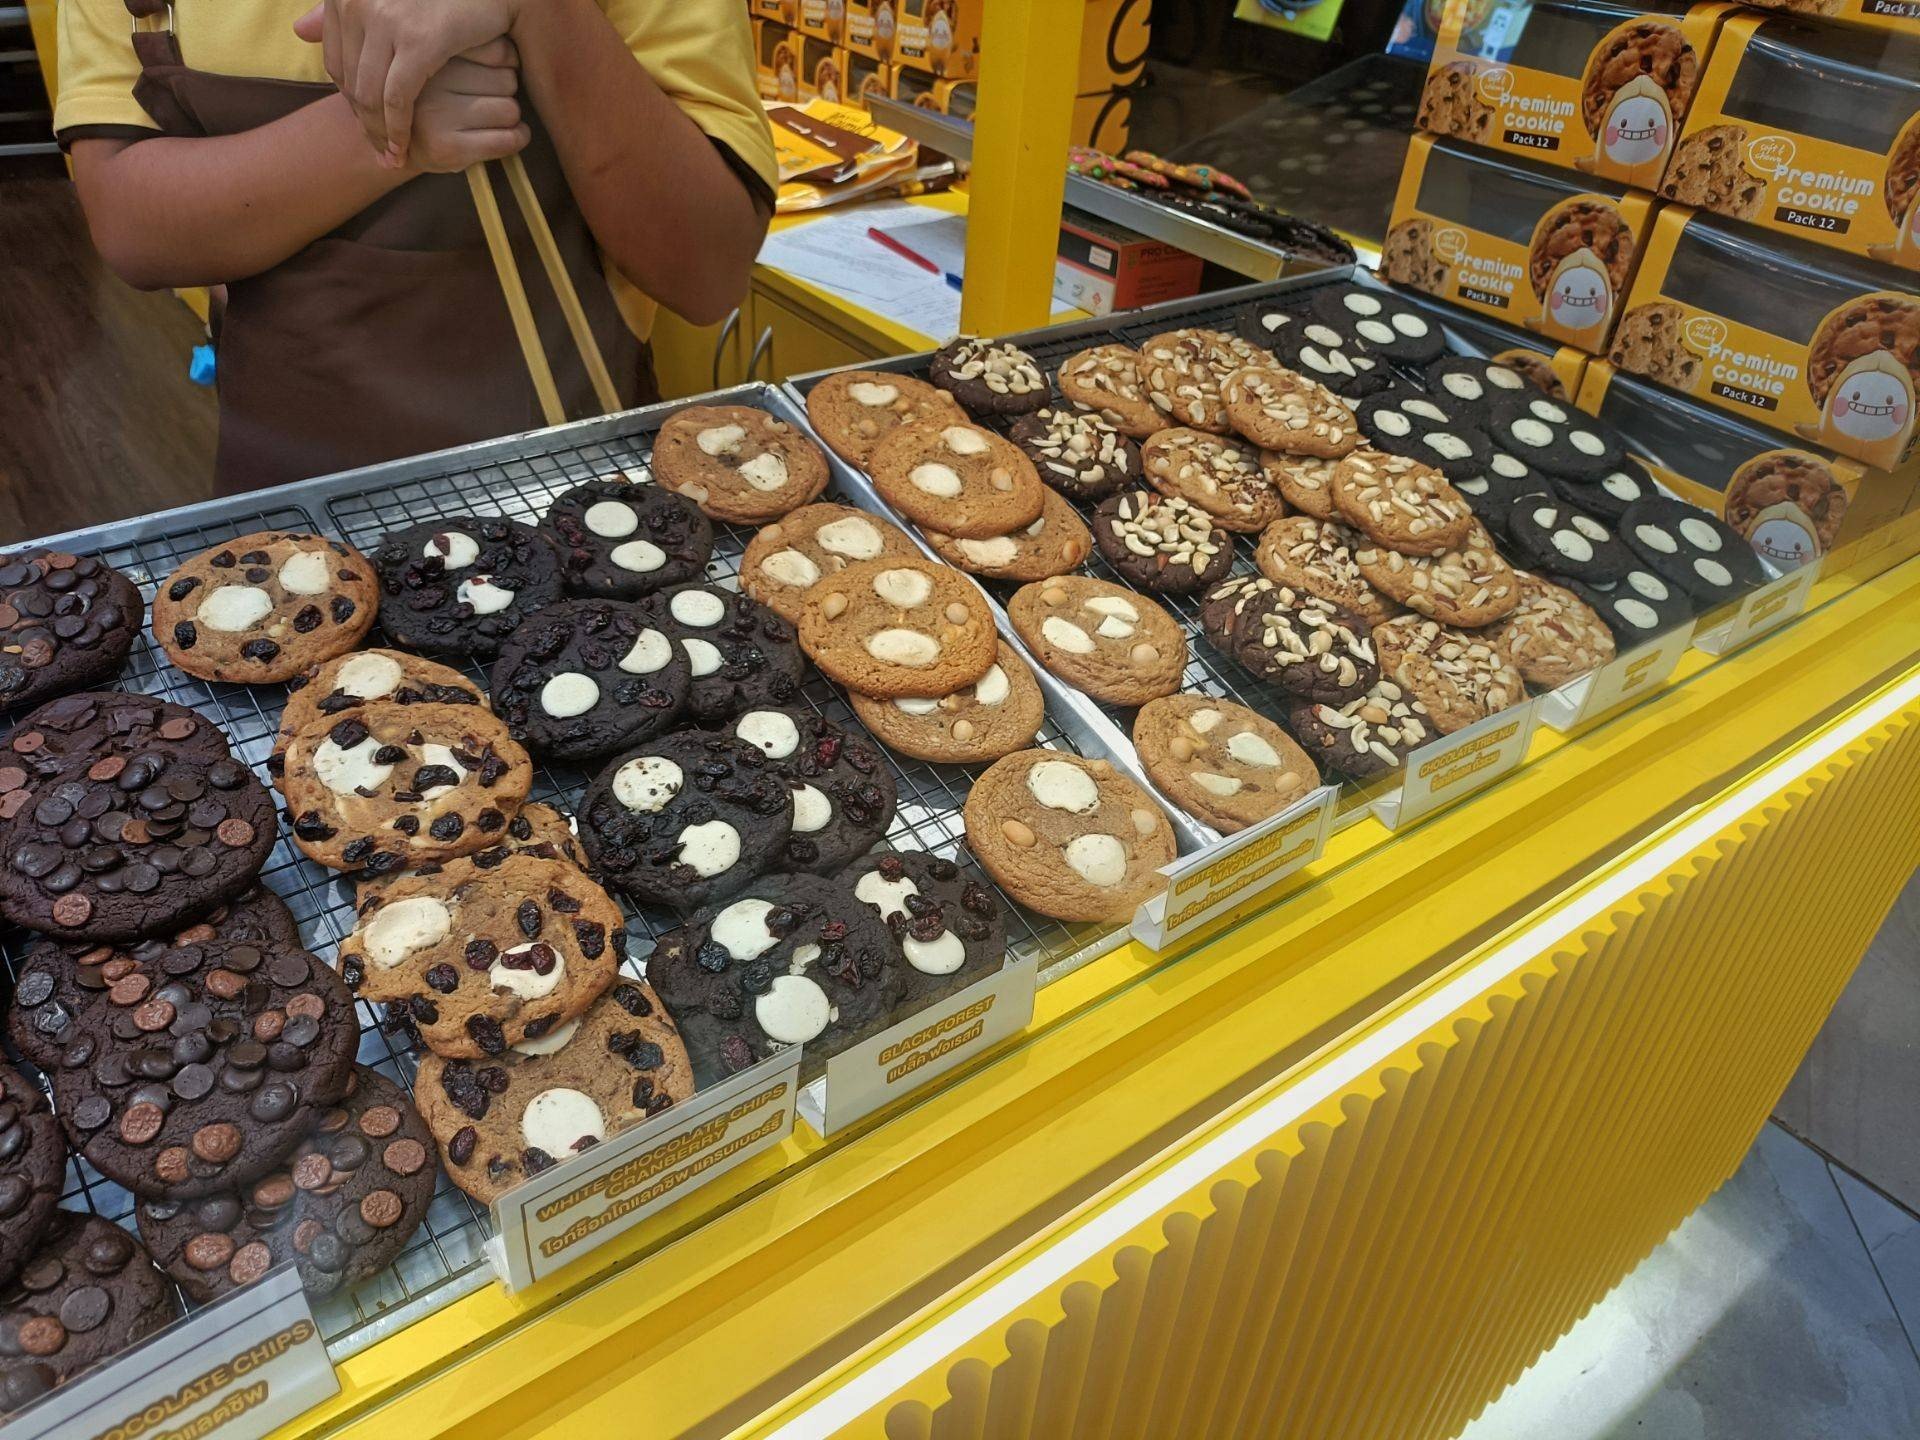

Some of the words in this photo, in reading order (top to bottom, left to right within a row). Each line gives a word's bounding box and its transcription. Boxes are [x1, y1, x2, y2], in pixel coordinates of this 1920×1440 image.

[1875, 0, 1906, 14] Pack
[1500, 91, 1575, 117] Premium
[1503, 112, 1565, 133] Cookie
[1512, 133, 1535, 146] Pack
[1536, 137, 1549, 148] 12
[1773, 164, 1875, 196] Premium
[1777, 186, 1859, 215] Cookie
[1787, 211, 1815, 226] Pack
[1818, 217, 1836, 230] 12
[1454, 251, 1524, 280] Premium
[1458, 269, 1514, 294] Cookie
[1466, 289, 1487, 302] Pack
[1489, 295, 1500, 306] 12
[1708, 344, 1799, 380] Premium
[1711, 364, 1785, 395] Cookie
[1722, 386, 1748, 401] Pack
[1750, 395, 1766, 407] 12
[1176, 869, 1214, 895] WHITE
[1215, 832, 1284, 871] CHOCOLATE
[1210, 840, 1282, 887] MACADAMIA
[880, 1029, 932, 1064] BLACK
[935, 995, 995, 1036] FOREST
[538, 1178, 607, 1220] WHITE
[608, 1114, 728, 1184] CHOCOLATE
[728, 1082, 787, 1122] CHIPS
[606, 1126, 726, 1197] CRANBERRY
[93, 1366, 230, 1440] OCOLATE
[231, 1320, 314, 1376] CHIPS
